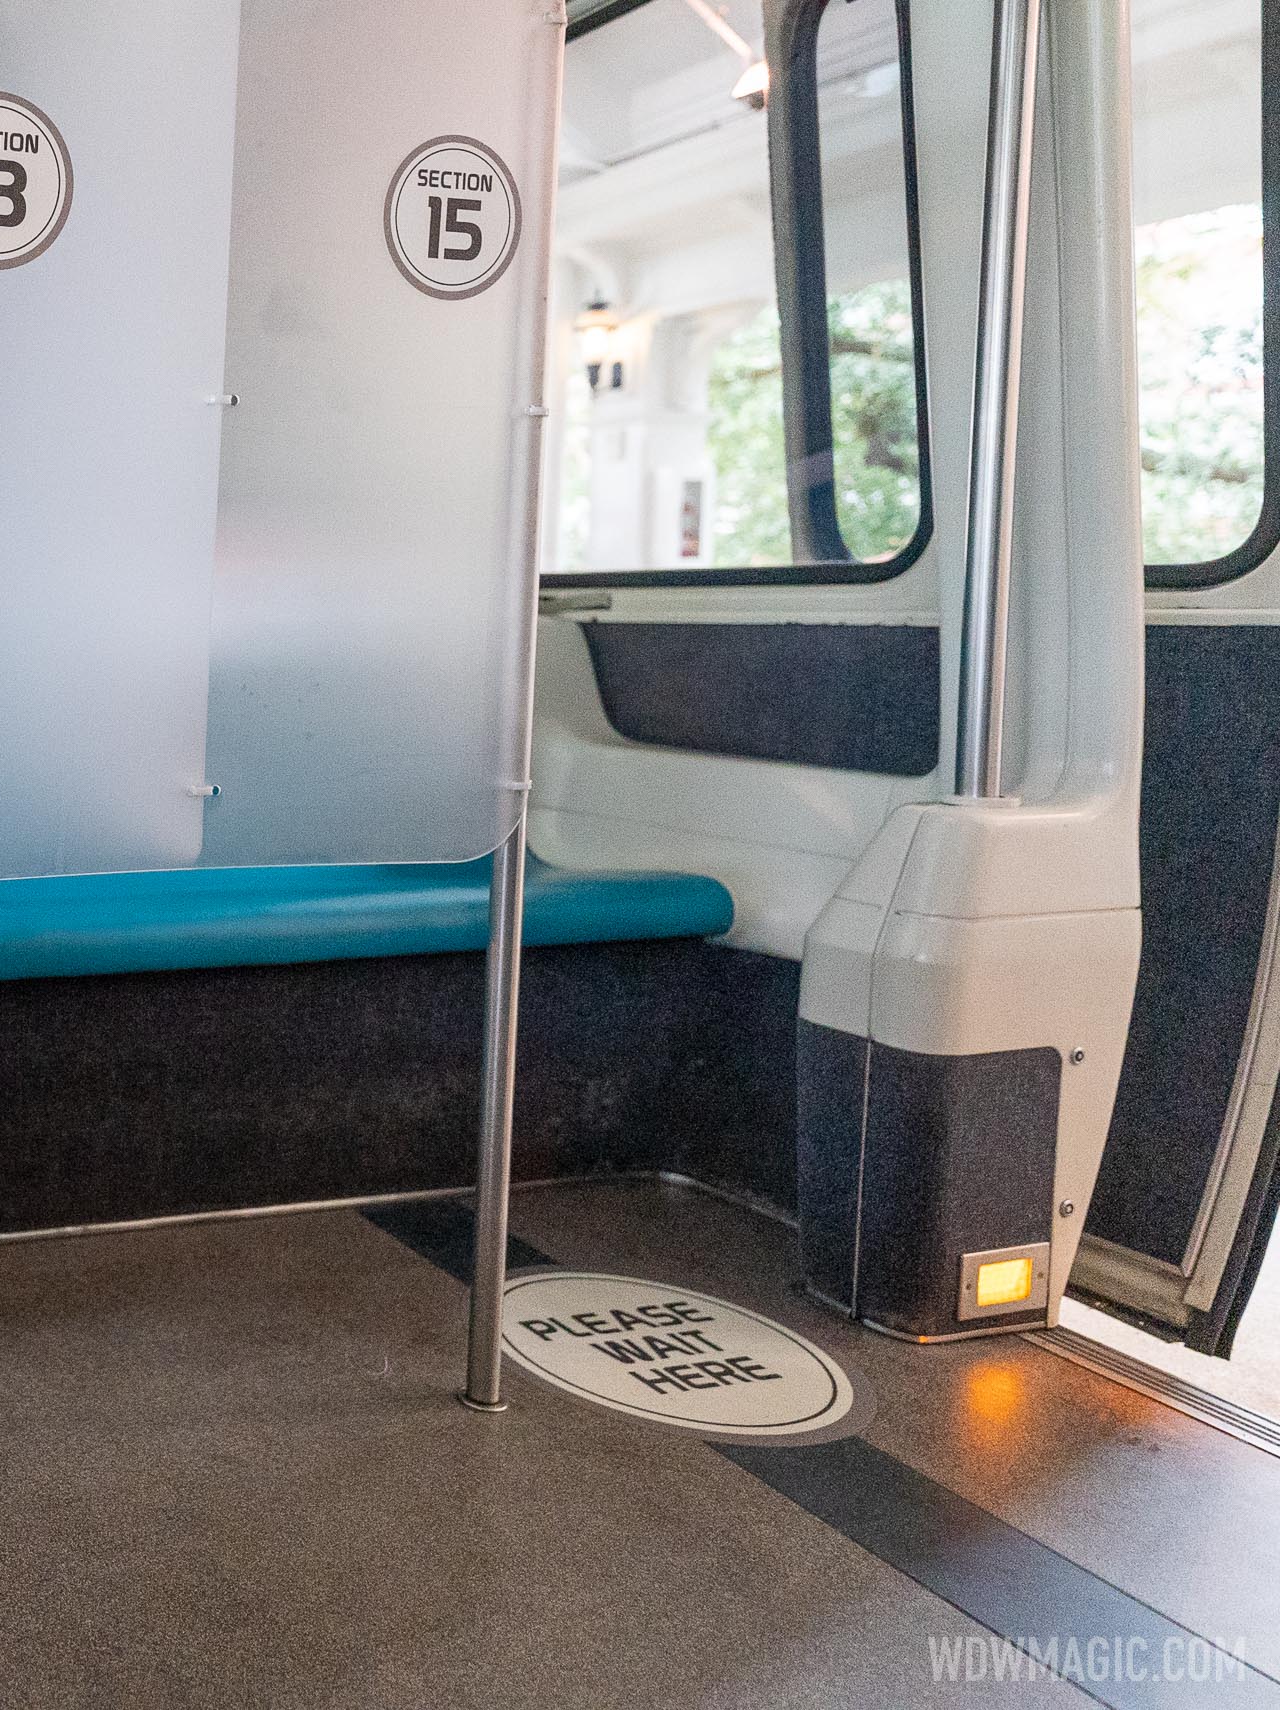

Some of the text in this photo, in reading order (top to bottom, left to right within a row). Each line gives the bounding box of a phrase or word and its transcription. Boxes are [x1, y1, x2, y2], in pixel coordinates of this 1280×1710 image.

[417, 169, 493, 192] SECTION
[427, 195, 483, 261] 15
[518, 1301, 717, 1341] PLEASE
[591, 1329, 724, 1364] WAIT
[628, 1355, 783, 1394] HERE
